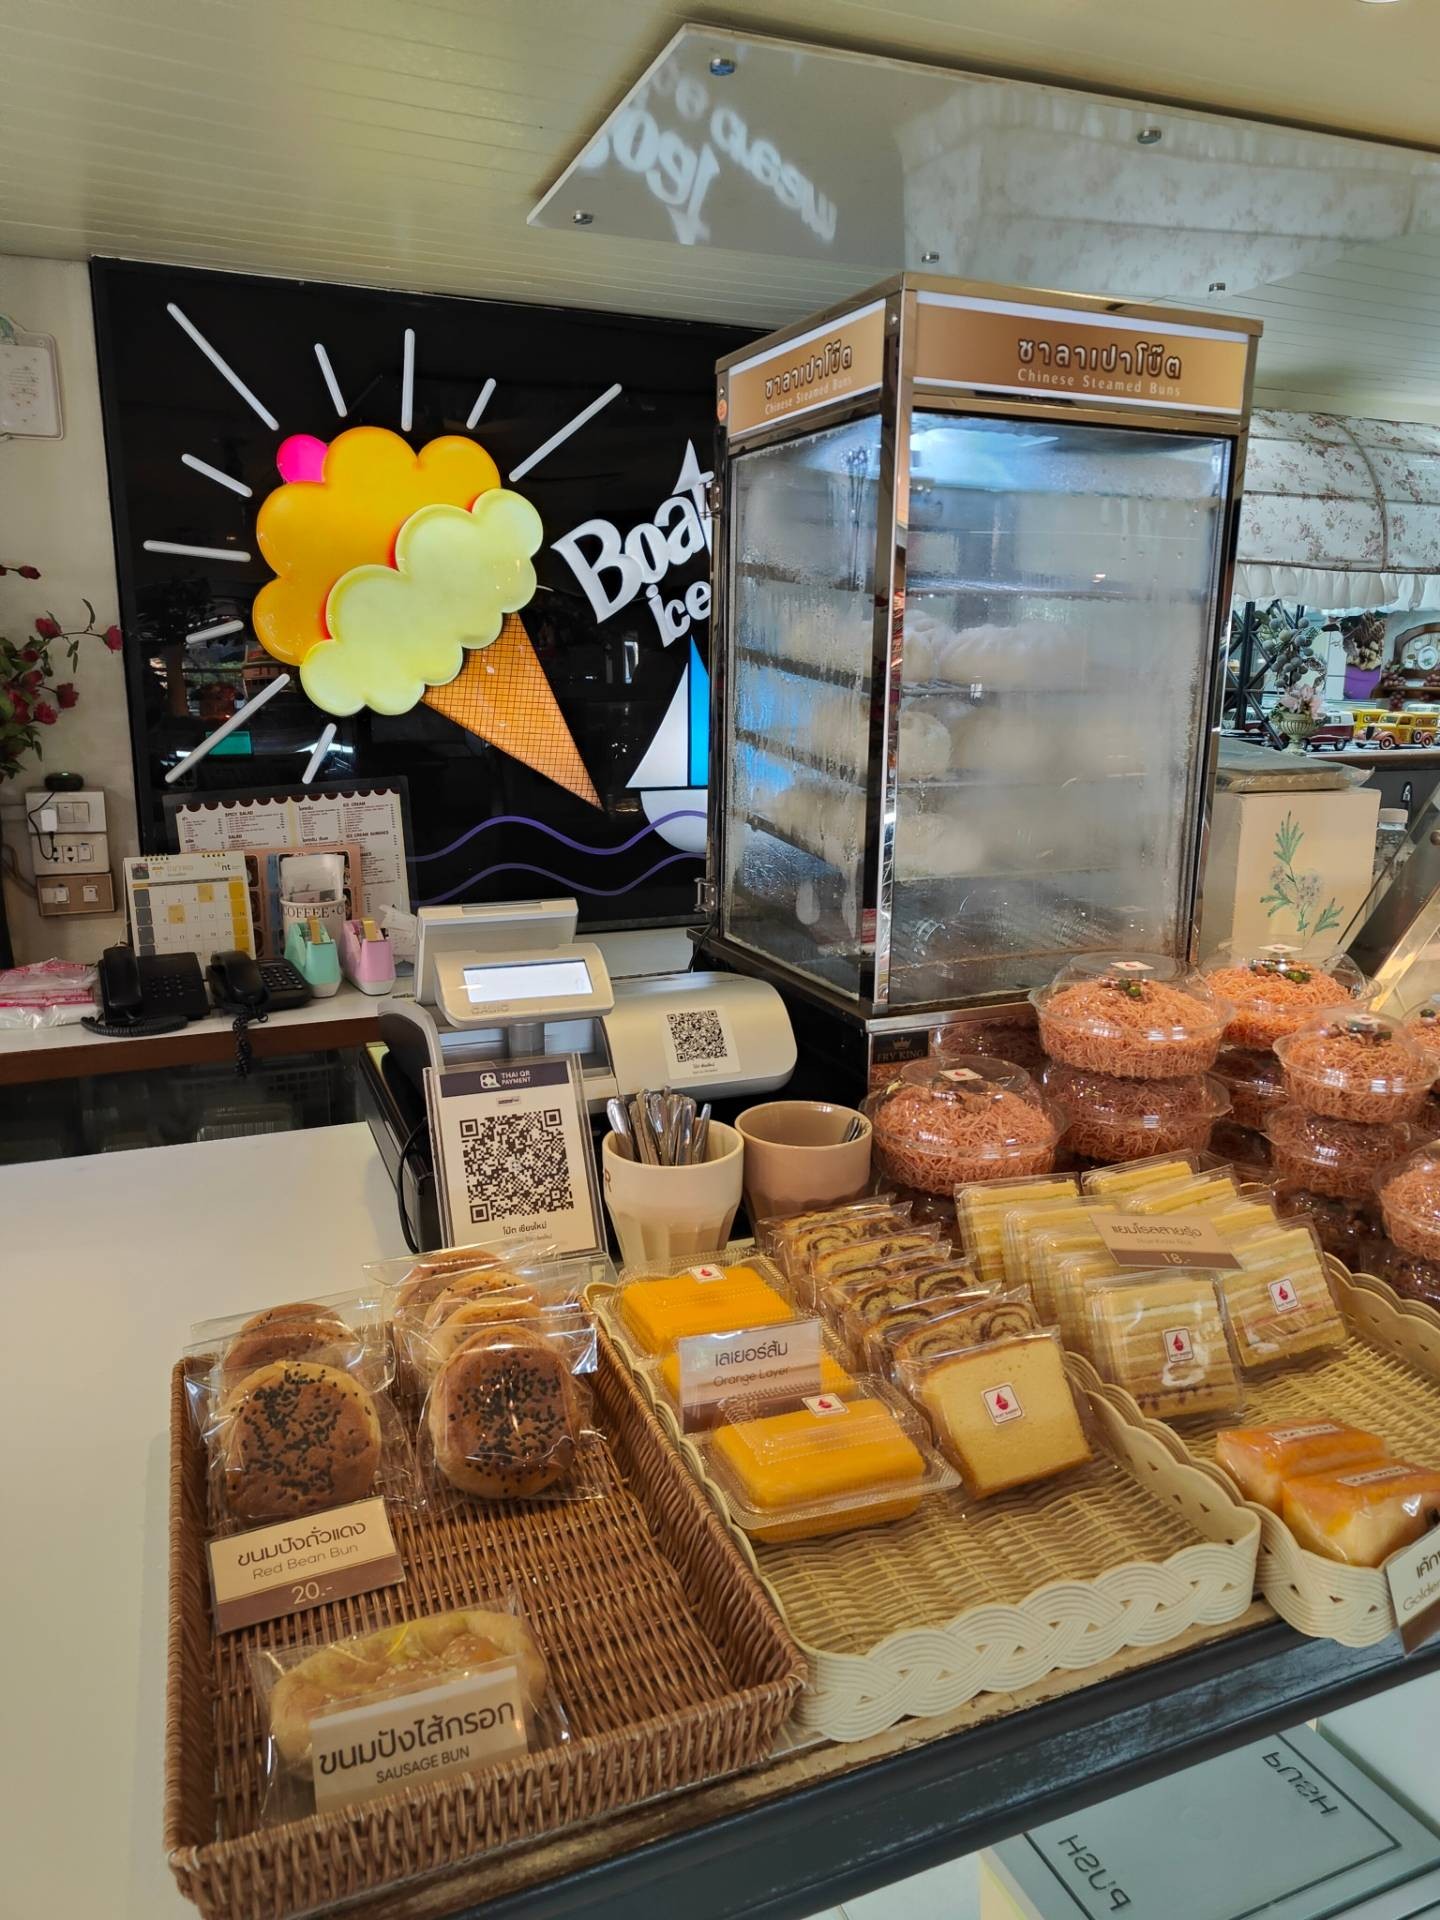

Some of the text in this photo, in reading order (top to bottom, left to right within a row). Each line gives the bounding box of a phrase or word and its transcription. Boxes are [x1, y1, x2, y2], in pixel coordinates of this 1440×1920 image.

[1018, 338, 1182, 379] ซาลาเปาโบ๊ต
[1018, 368, 1182, 397] Chinese Steamed Buns
[550, 438, 713, 625] Boat
[645, 580, 712, 648] ice
[501, 1071, 519, 1079] THAI
[501, 1076, 531, 1086] PAYMENT
[715, 1340, 789, 1367] เลเยอร์ส้ม
[713, 1366, 789, 1387] Orange Layer
[237, 1522, 366, 1567] ขนมปังถั่วแดง
[252, 1543, 359, 1580] Red Bean Bun
[291, 1581, 334, 1605] 20.-
[319, 1702, 515, 1776] ขนมปังไส้กรอก
[376, 1745, 471, 1784] SAUSAGE BUN
